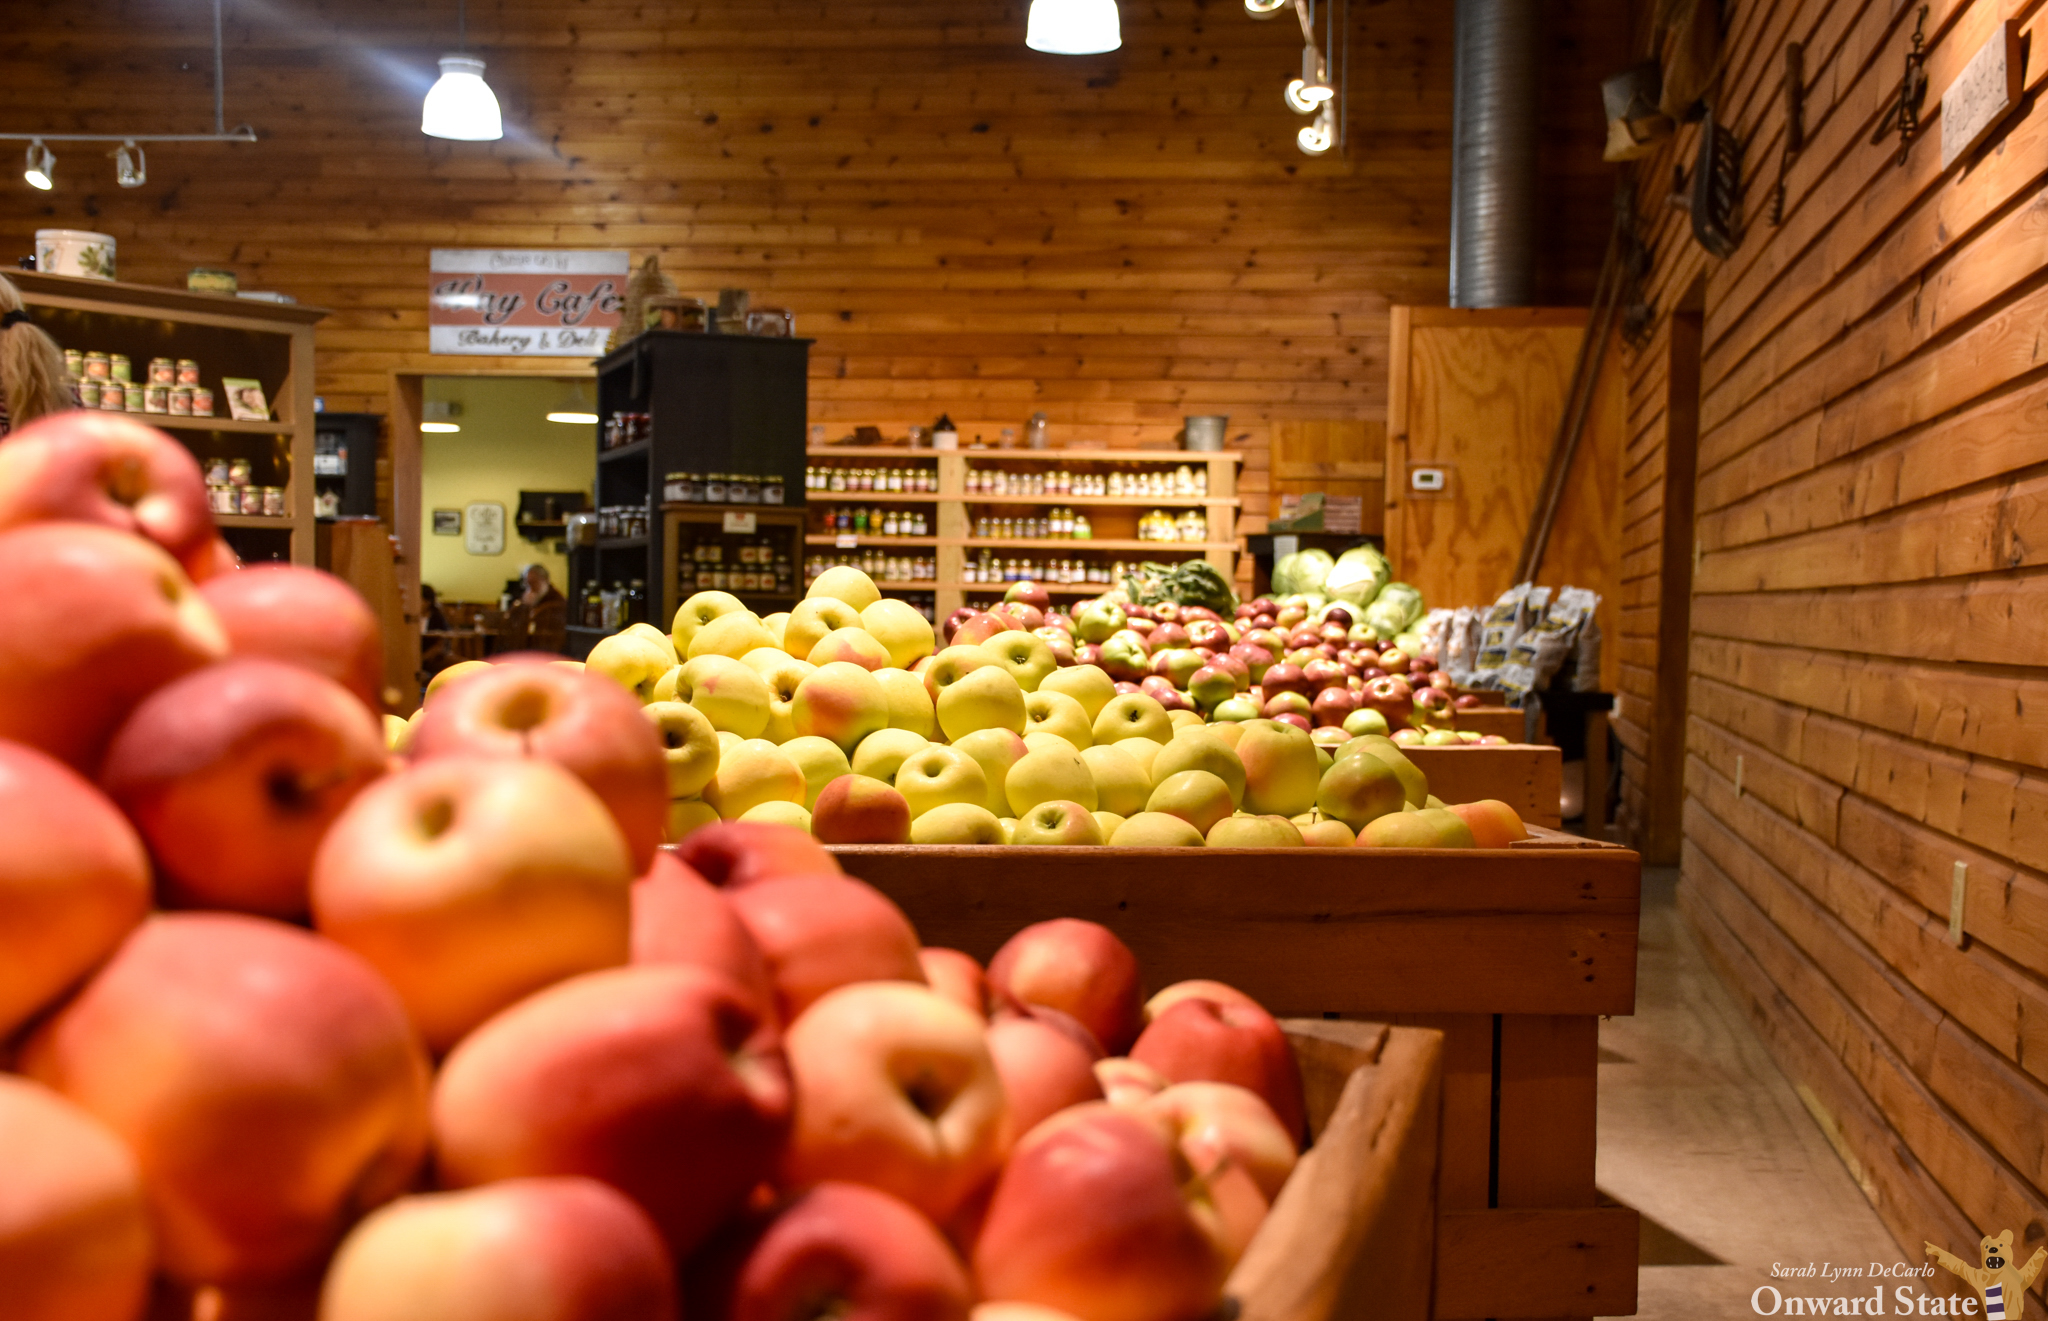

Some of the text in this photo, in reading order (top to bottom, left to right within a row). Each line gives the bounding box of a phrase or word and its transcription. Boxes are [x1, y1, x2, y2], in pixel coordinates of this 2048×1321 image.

[458, 330, 600, 352] Bakery & Deli
